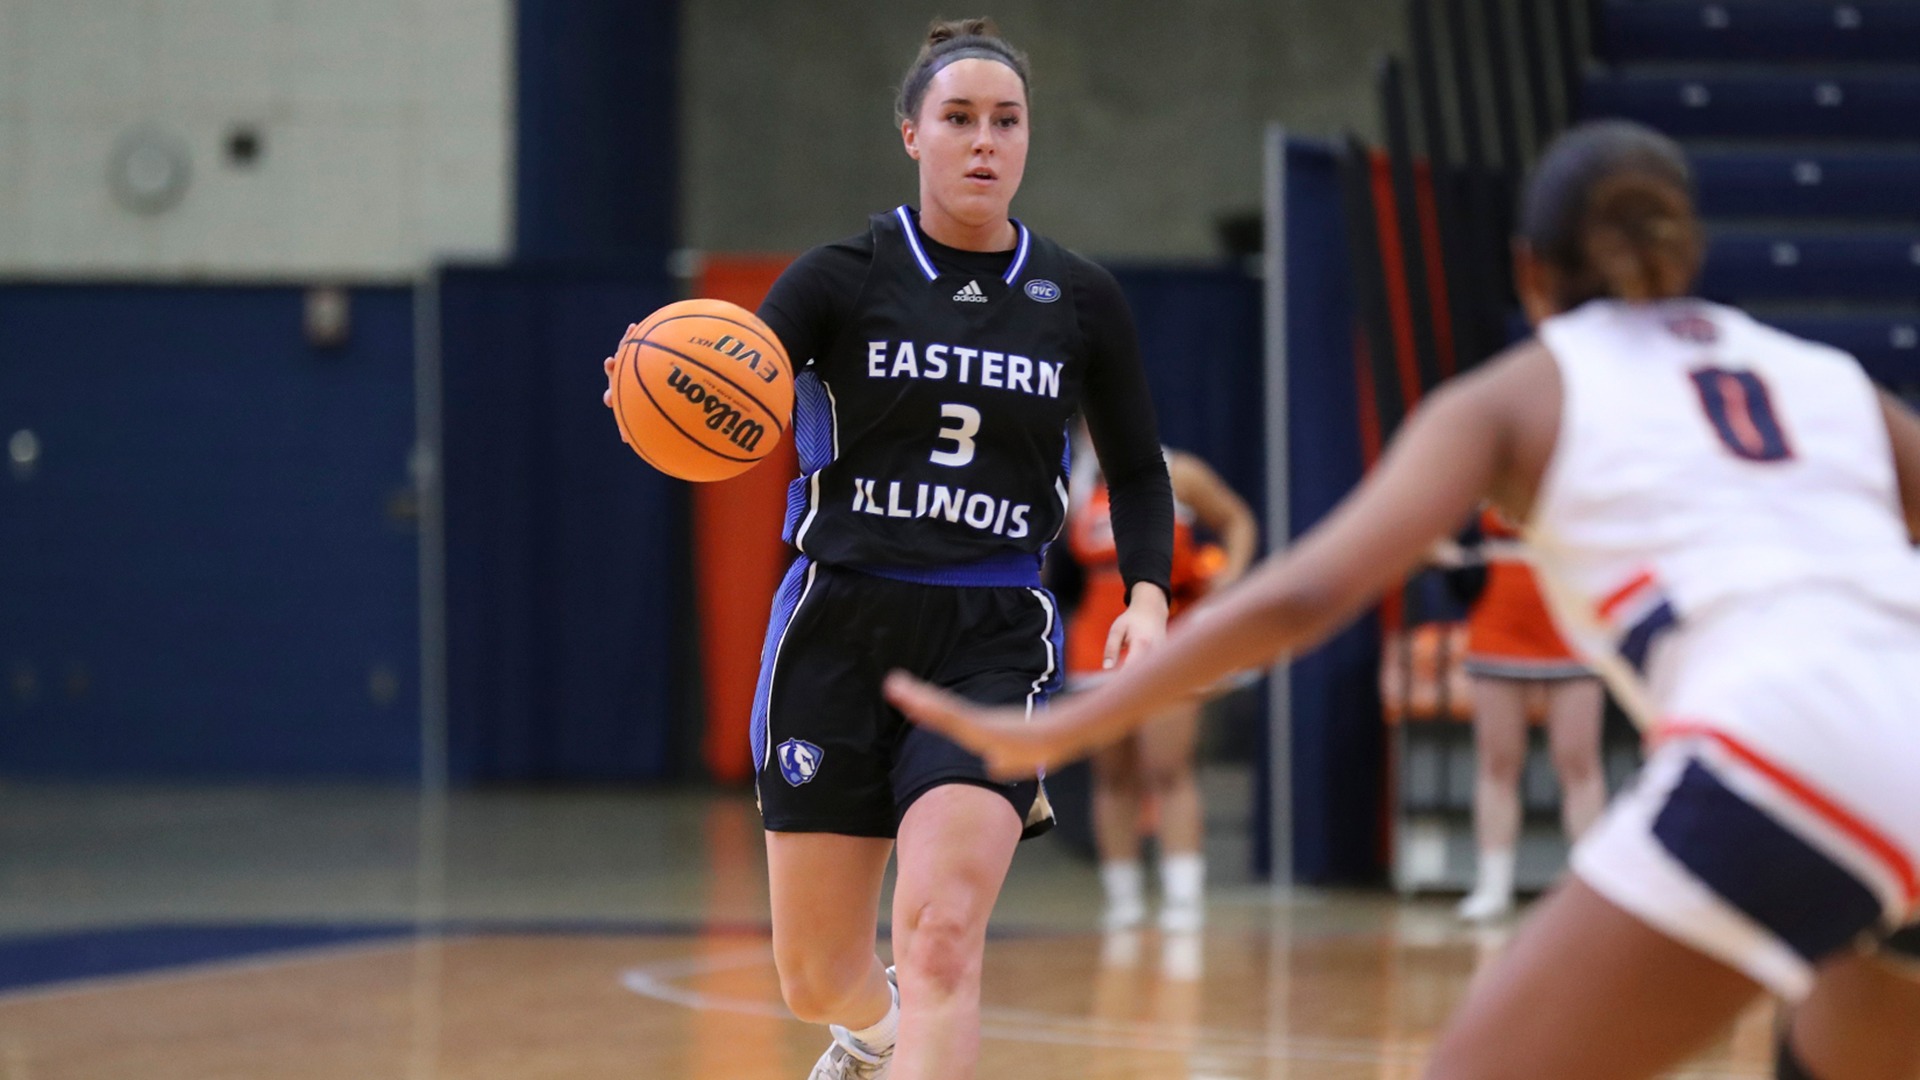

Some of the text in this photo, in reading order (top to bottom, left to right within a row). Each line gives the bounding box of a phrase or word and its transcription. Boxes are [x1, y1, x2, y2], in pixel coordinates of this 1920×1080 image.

[952, 294, 988, 303] adidas
[713, 335, 779, 384] EVO
[868, 340, 1064, 398] EASTERN
[667, 365, 765, 452] Wilson
[929, 403, 982, 467] 3
[1688, 366, 1793, 462] 0
[852, 478, 1031, 538] ILLINOIS
